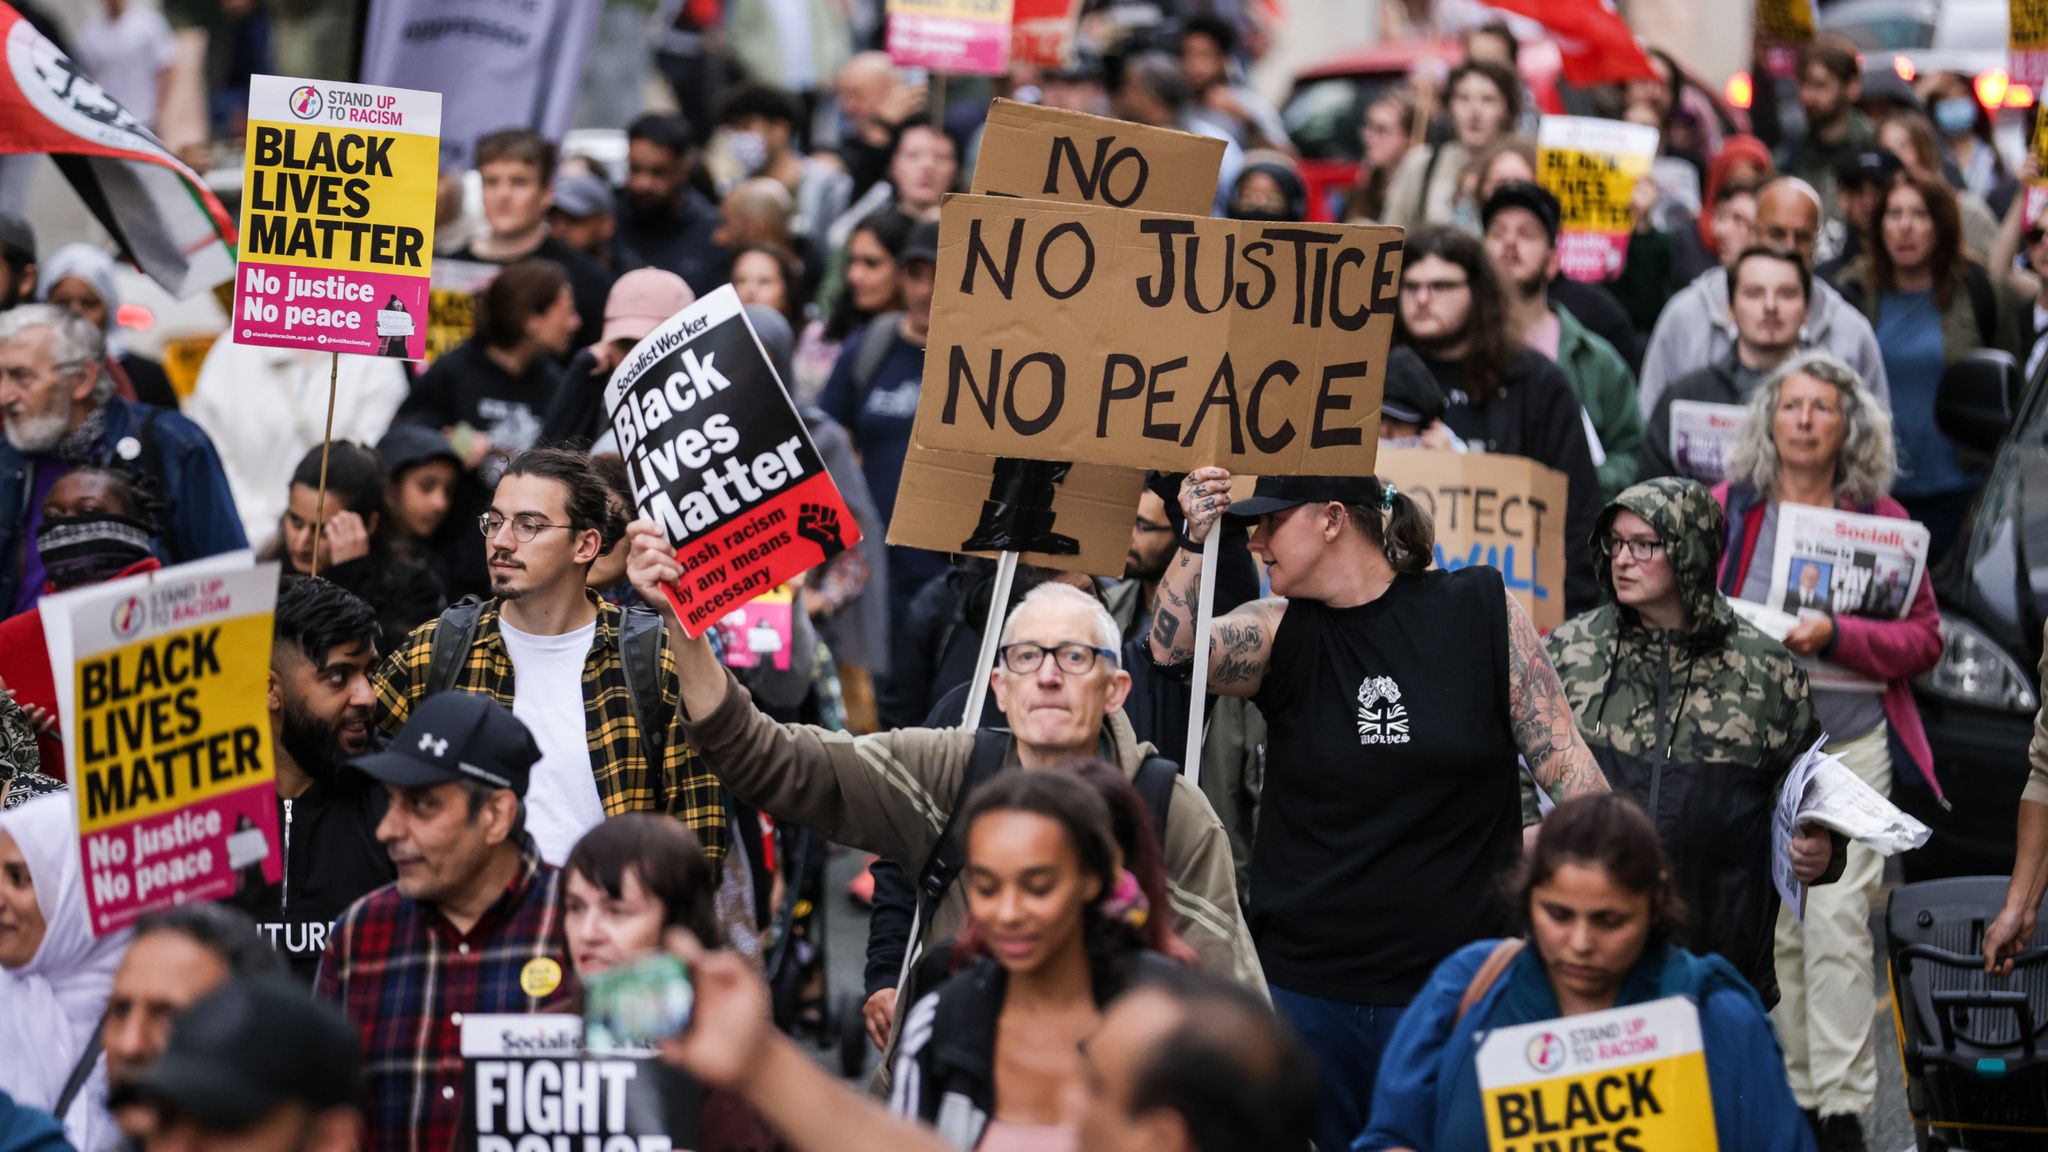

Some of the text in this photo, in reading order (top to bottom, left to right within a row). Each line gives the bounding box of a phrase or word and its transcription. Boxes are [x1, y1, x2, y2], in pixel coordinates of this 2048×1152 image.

[328, 90, 396, 110] STAND UP
[328, 106, 403, 126] TO RACISM
[254, 126, 396, 177] BLACK
[1042, 136, 1149, 207] NO
[251, 170, 371, 218] LIVES
[248, 214, 424, 267] MATTER
[245, 268, 374, 302] No justice
[960, 218, 1404, 332] NO JUSTICE
[243, 296, 279, 322] No
[284, 306, 361, 330] peace
[616, 314, 708, 396] Socialist Worker
[613, 348, 731, 463] Black
[941, 345, 1368, 455] NO PEACE
[626, 413, 740, 503] Lives
[637, 435, 804, 542] Matter
[672, 529, 792, 606] by any means
[678, 507, 787, 578] ash racism
[172, 595, 230, 623] RACISM
[200, 578, 224, 596] UP
[687, 565, 773, 625] necessary
[82, 626, 221, 710] BLACK
[83, 687, 201, 764] LIVES
[85, 724, 262, 820] MATTER
[88, 809, 221, 870] No justice
[92, 868, 130, 907] No
[135, 848, 213, 900] peace
[256, 921, 338, 952] TUR
[1568, 1017, 1647, 1046] STAND UP
[1572, 1035, 1659, 1065] TO RACISM
[475, 1060, 637, 1135] FIGHT
[1497, 1067, 1663, 1139] BLACK
